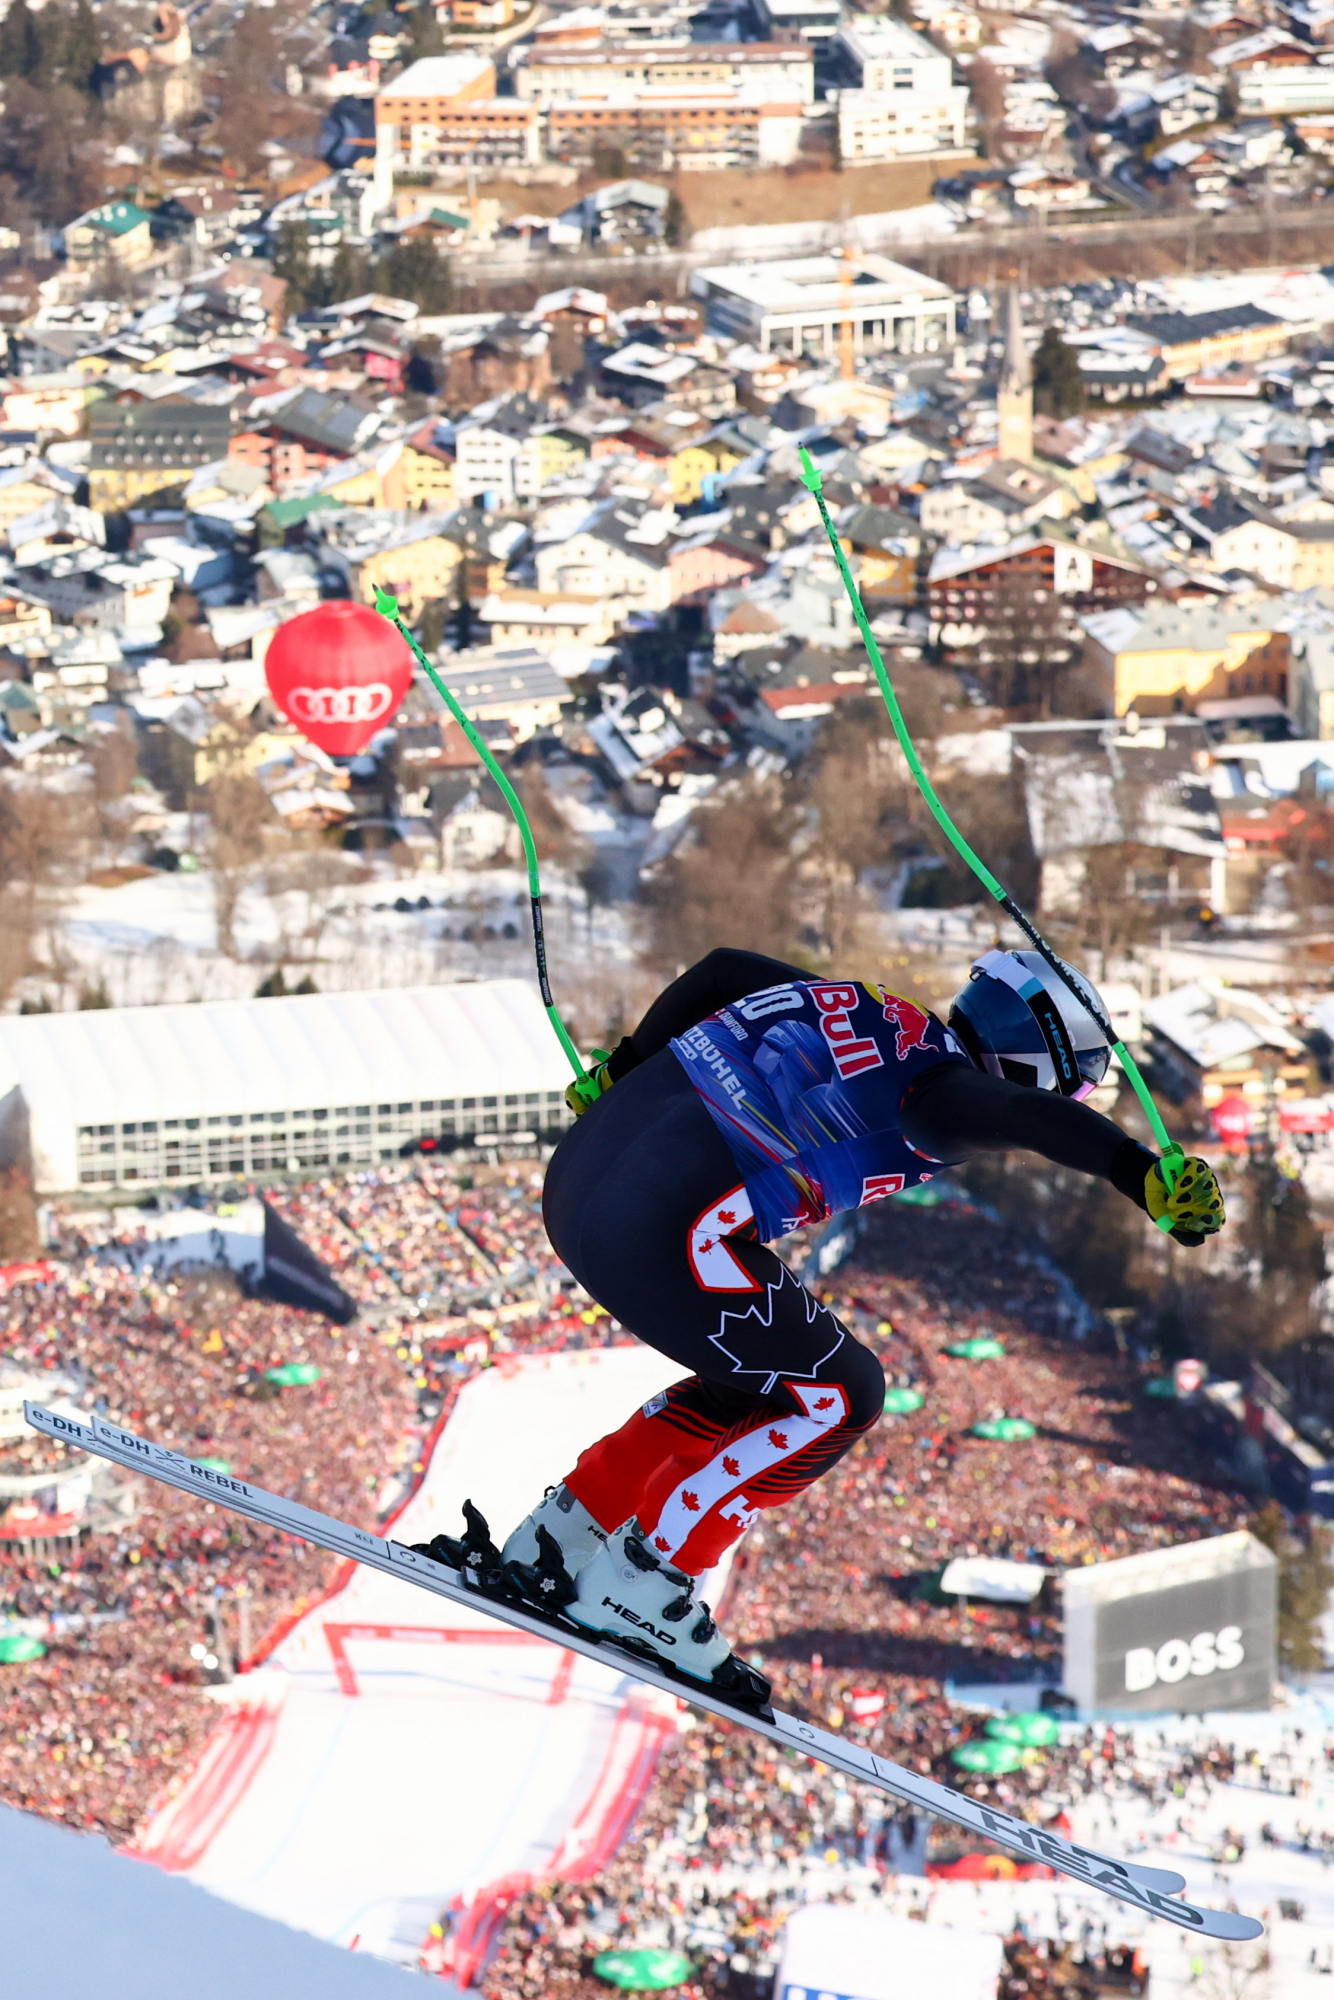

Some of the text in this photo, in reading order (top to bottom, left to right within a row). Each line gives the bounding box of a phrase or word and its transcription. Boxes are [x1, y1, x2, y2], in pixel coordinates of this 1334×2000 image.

[808, 984, 884, 1080] Bull
[1044, 1012, 1072, 1080] HEAD
[190, 1464, 254, 1499] REBEL
[602, 1596, 677, 1646] HEAD
[1124, 1626, 1245, 1692] BOSS
[980, 1811, 1204, 1925] HEAD
